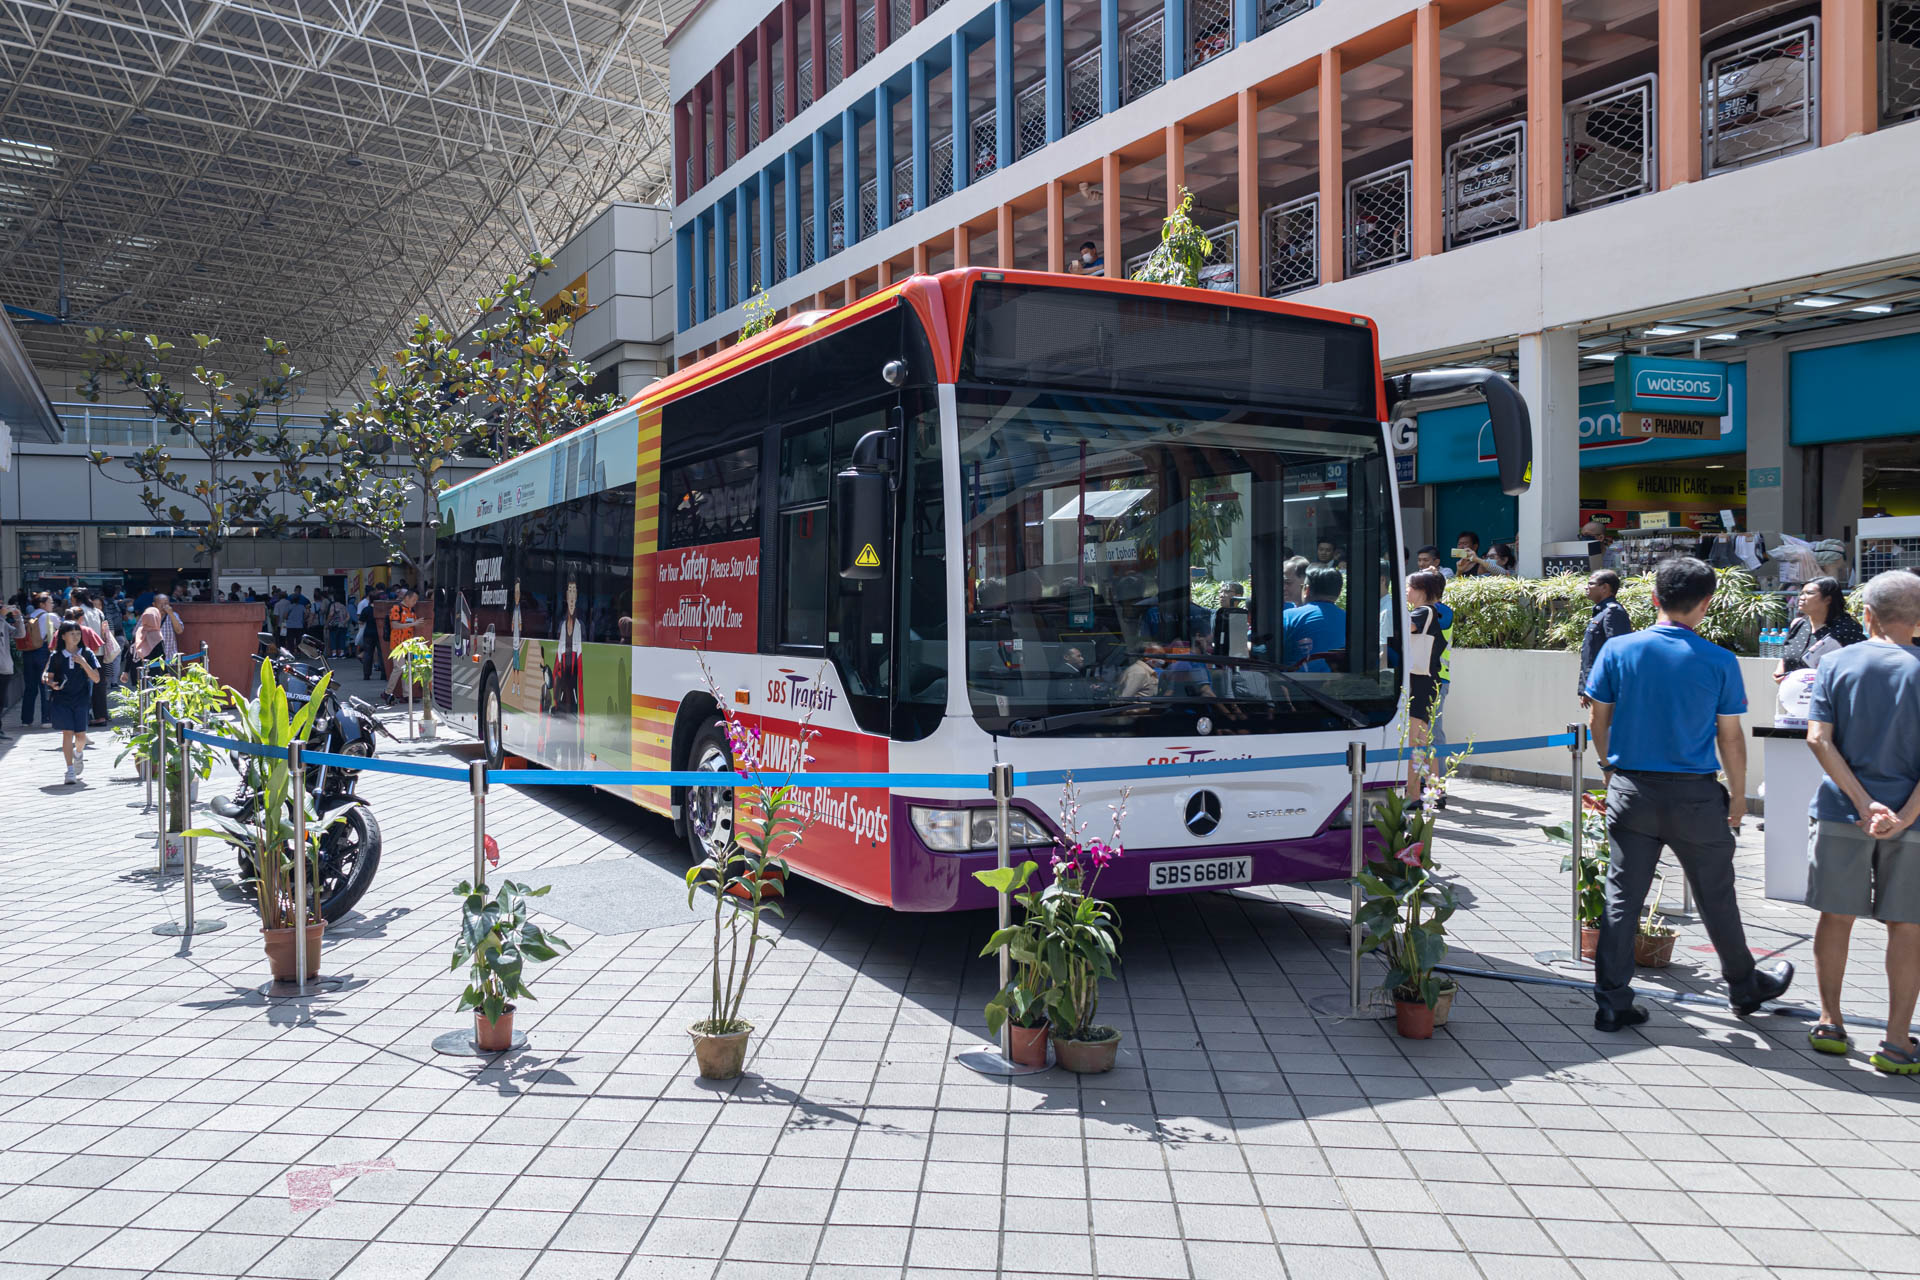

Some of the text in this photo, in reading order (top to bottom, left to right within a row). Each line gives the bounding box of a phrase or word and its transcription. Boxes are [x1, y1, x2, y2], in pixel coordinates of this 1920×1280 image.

[1647, 377, 1711, 394] watsons
[1655, 418, 1705, 435] PHARMACY
[1327, 465, 1342, 477] 30
[1683, 477, 1709, 495] CARE
[659, 564, 667, 582] For
[668, 563, 679, 582] Your
[710, 558, 730, 579] Please
[730, 556, 744, 582] Stay
[745, 555, 759, 576] Out
[481, 585, 493, 605] before
[662, 598, 743, 636] of Our Blind Spot Zone
[767, 674, 838, 711] SBS Transit
[761, 732, 809, 774] AWARE
[789, 786, 812, 818] Bus
[813, 786, 848, 830] Blind
[847, 794, 889, 844] Spots
